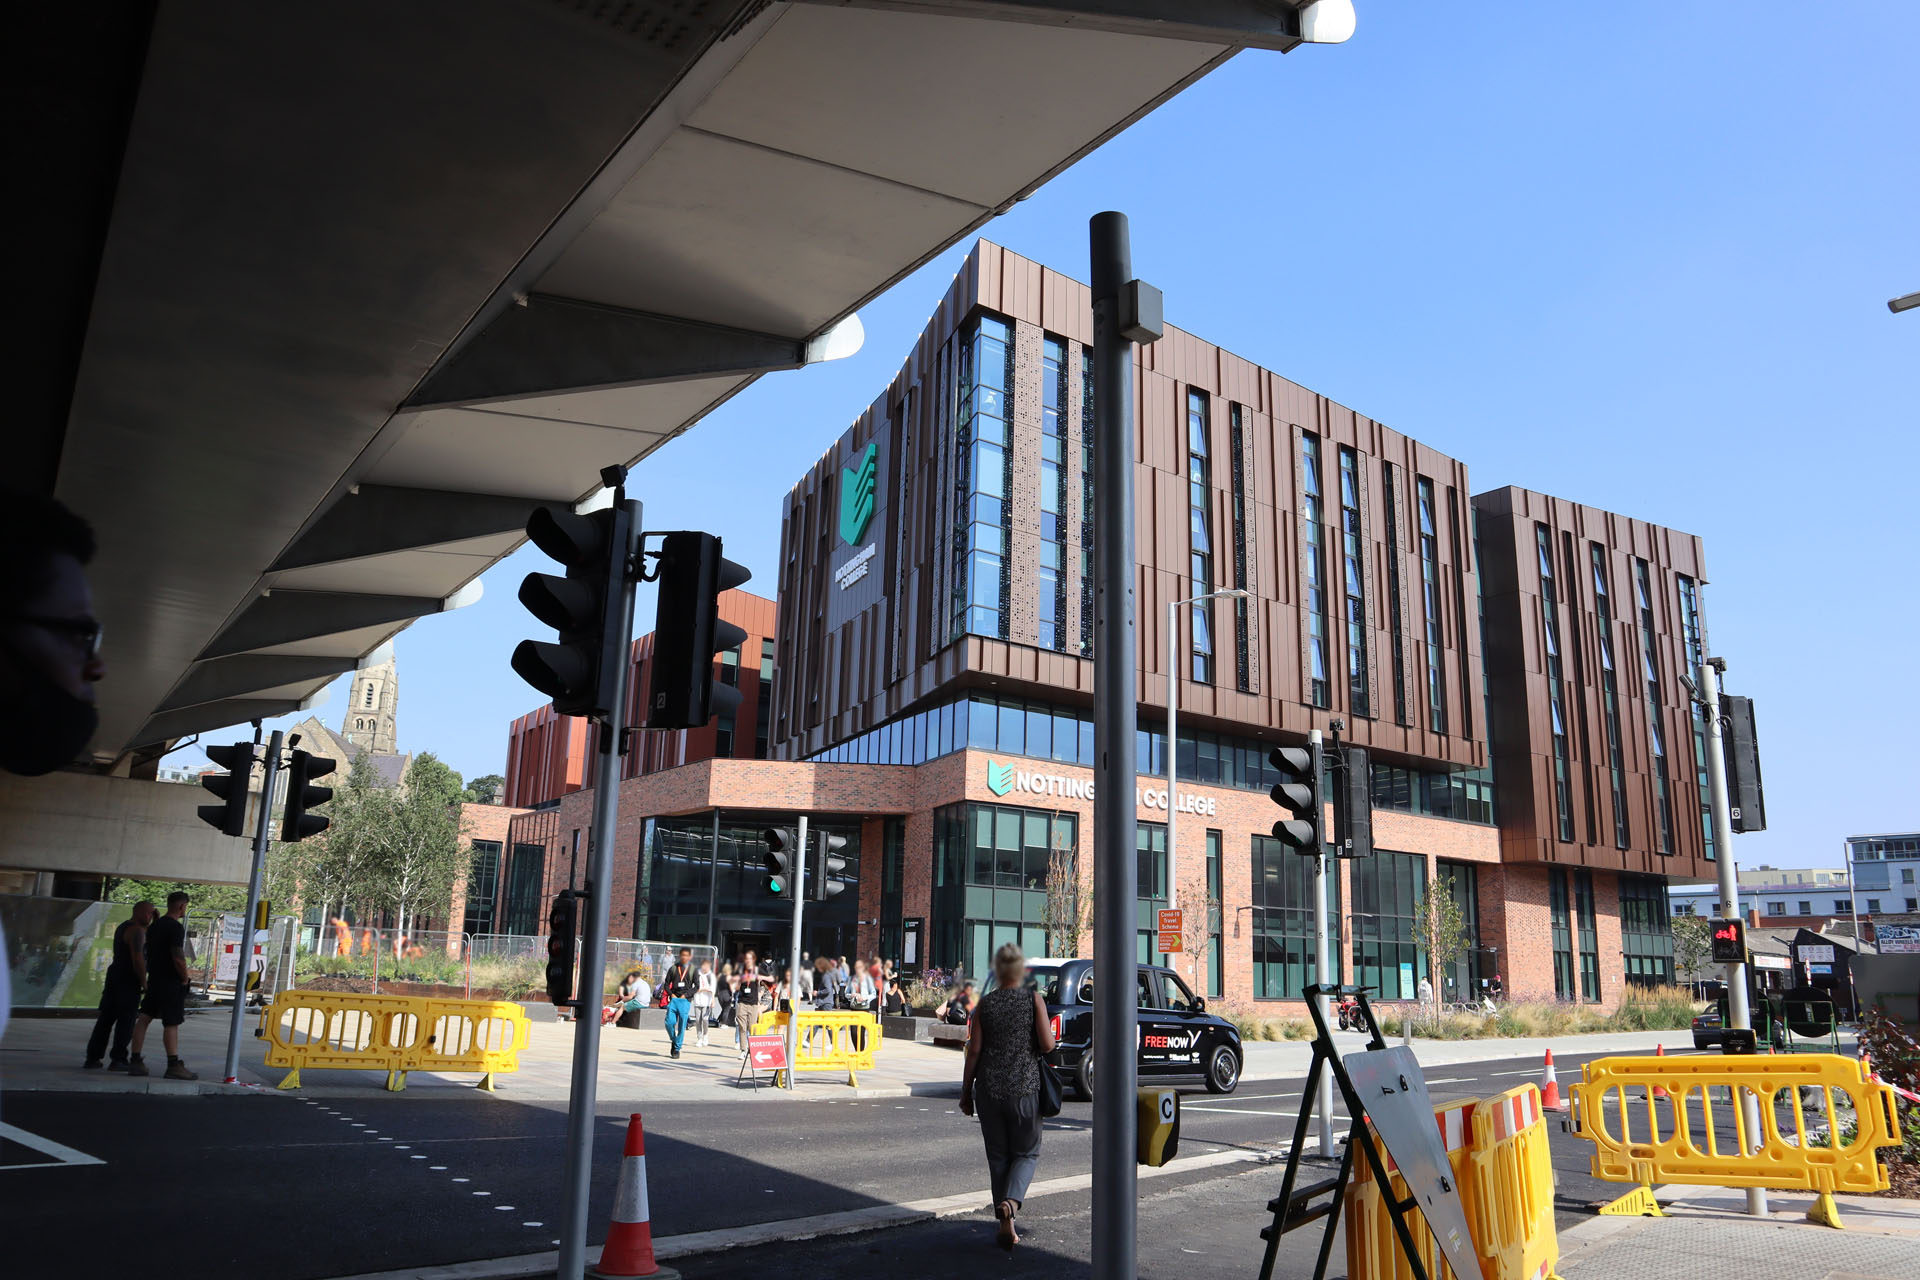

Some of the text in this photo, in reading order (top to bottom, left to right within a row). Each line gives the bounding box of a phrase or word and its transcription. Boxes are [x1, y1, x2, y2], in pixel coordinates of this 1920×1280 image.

[1016, 771, 1216, 816] NOTTING COLEGE
[1733, 809, 1740, 818] 6
[1346, 839, 1352, 847] 5
[1726, 900, 1731, 908] 6
[1162, 1098, 1172, 1119] C
